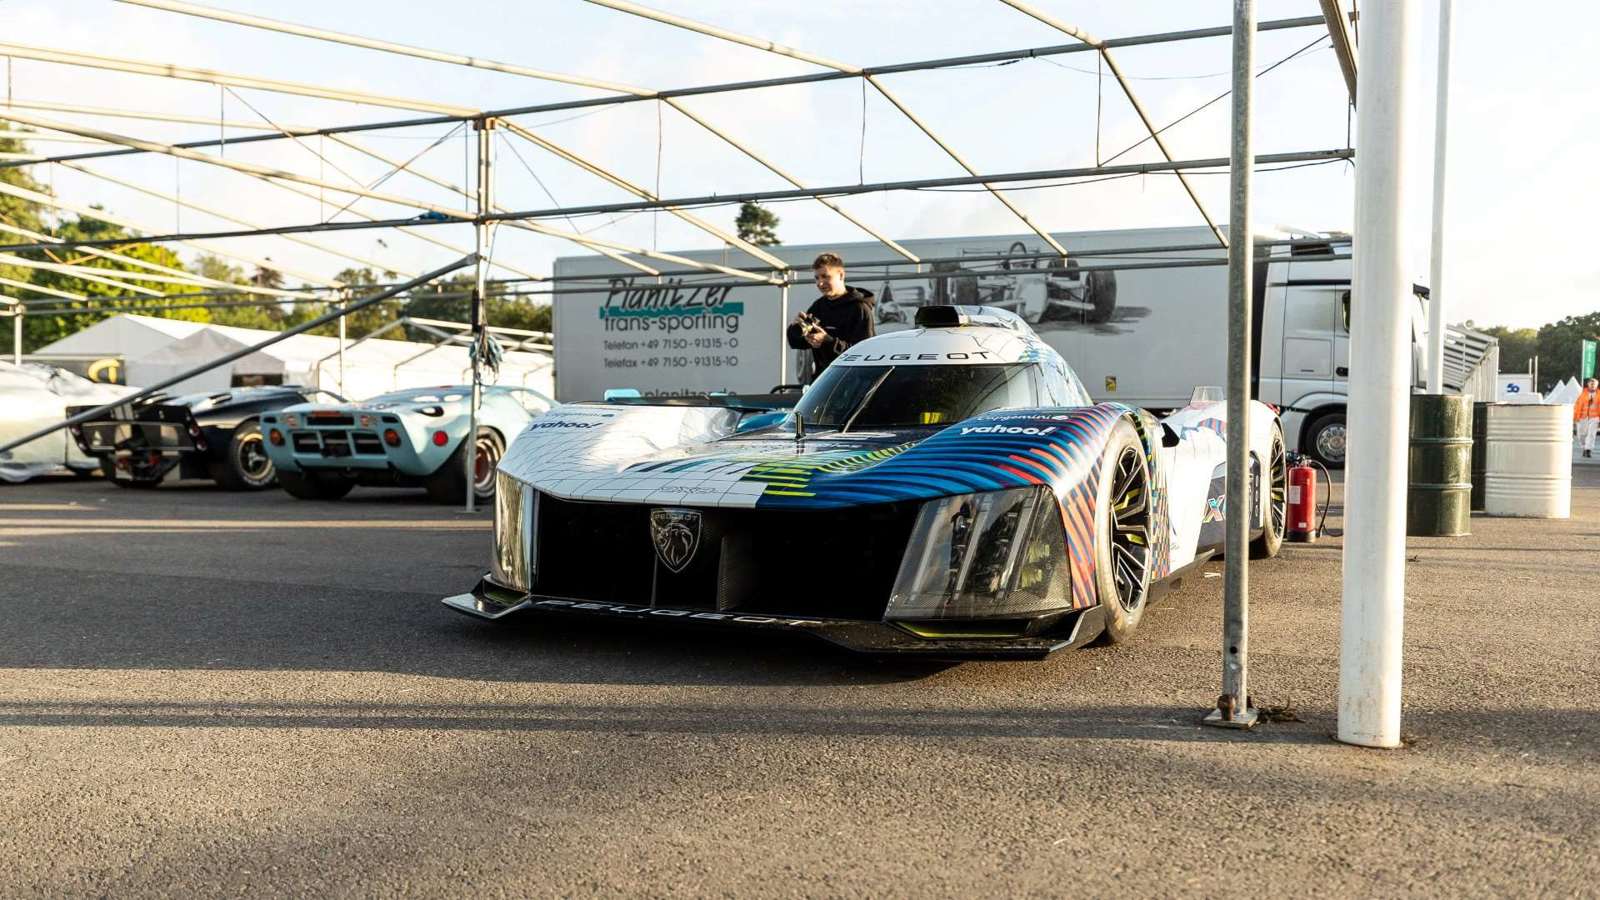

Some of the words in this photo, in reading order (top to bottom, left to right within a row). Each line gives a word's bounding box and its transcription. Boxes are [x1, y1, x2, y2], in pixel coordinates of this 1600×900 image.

[604, 312, 739, 333] trans-sporting
[604, 340, 638, 350] Telefon
[604, 358, 637, 368] Telefax
[529, 420, 603, 431] yahoo!
[961, 424, 1057, 436] yahoo!
[536, 599, 822, 626] PEUGEOT
